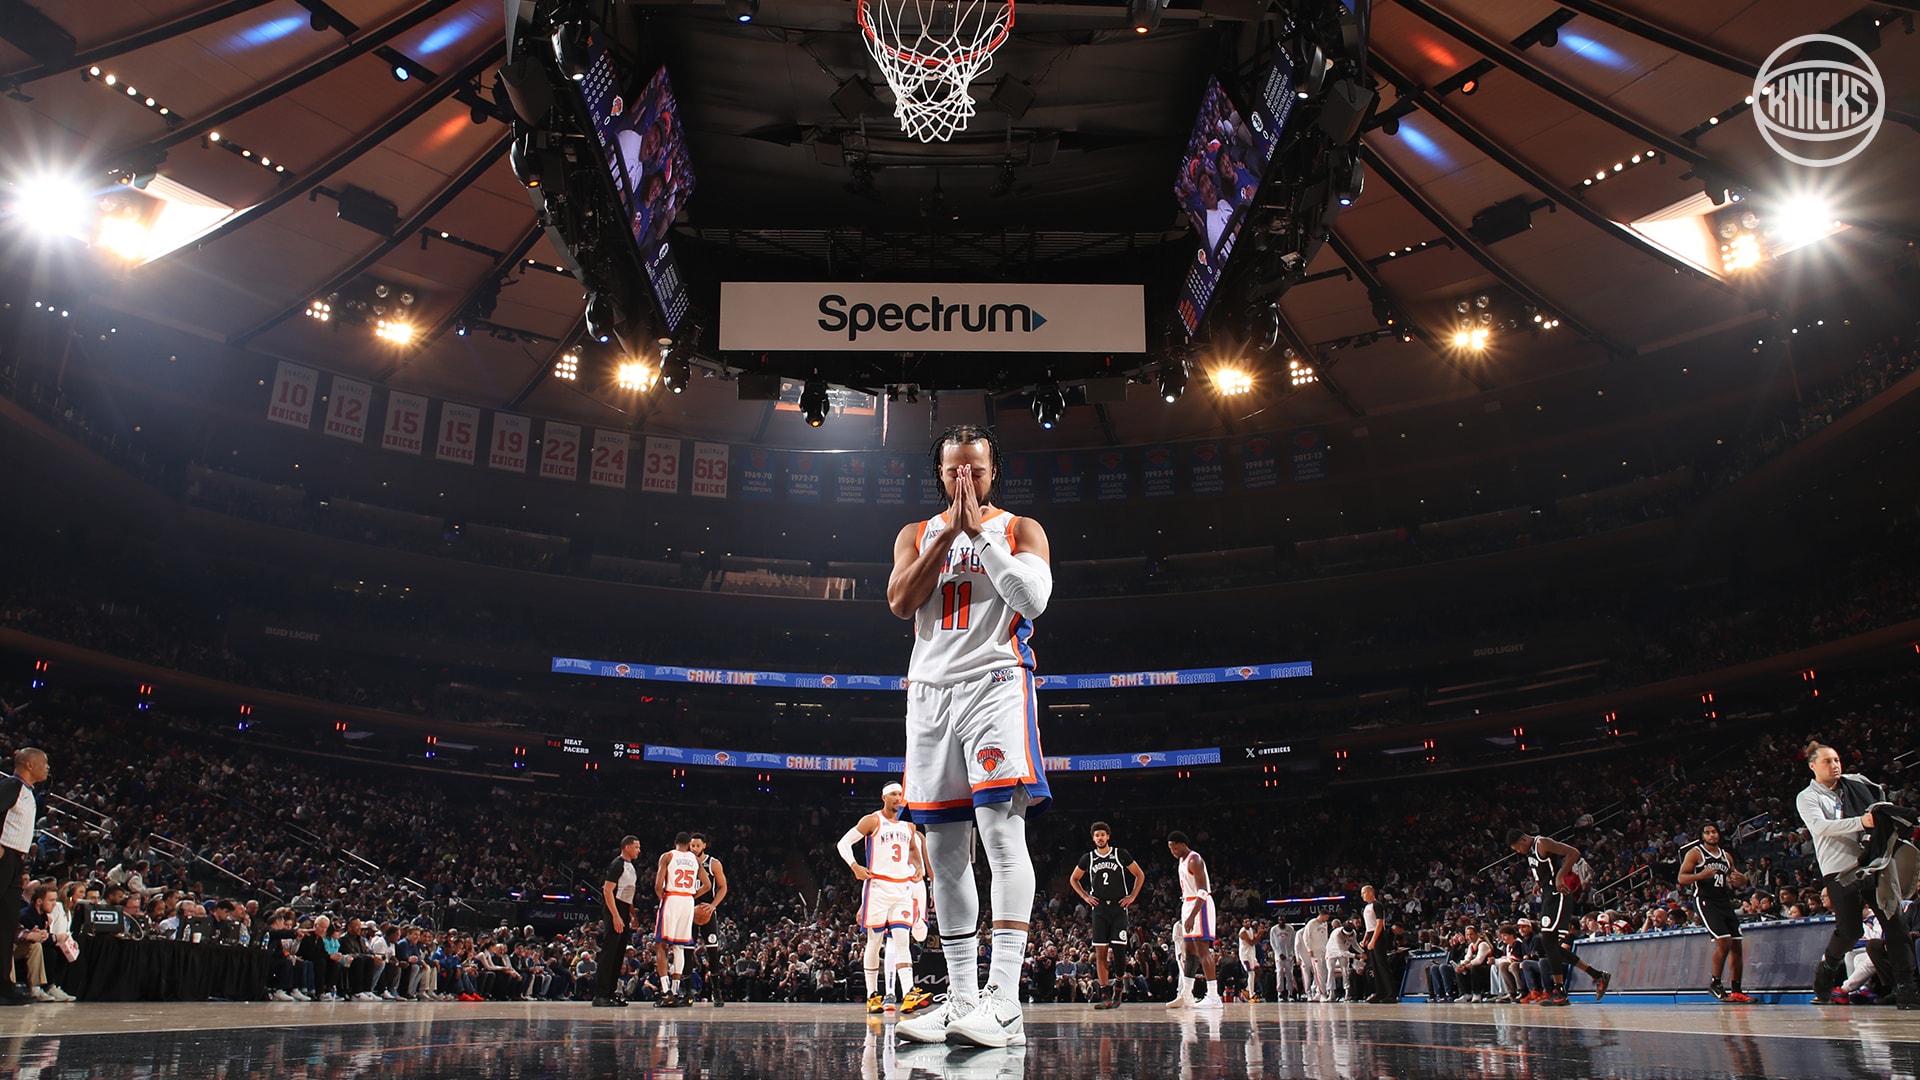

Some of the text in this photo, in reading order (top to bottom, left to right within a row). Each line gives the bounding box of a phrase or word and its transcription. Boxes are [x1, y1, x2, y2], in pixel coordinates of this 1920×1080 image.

[818, 294, 1031, 341] Spectrum
[279, 381, 308, 407] 10
[270, 406, 308, 424] KNICKS
[335, 396, 362, 422] 12
[328, 420, 362, 438] KNICKS
[392, 410, 419, 434] 15
[446, 420, 472, 444] 15
[384, 434, 420, 450] KNICKS
[498, 430, 522, 452] 19
[439, 445, 472, 460] KNICKS
[545, 438, 576, 462] 22
[492, 454, 524, 468] KNICKS
[595, 446, 624, 470] 24
[646, 453, 676, 475] 33
[542, 463, 576, 476] KNICKS
[694, 458, 726, 480] 613
[592, 470, 624, 484] KNICKS
[644, 478, 676, 490] KNICKS
[694, 482, 725, 494] KNICKS
[942, 581, 972, 630] 11
[1473, 643, 1525, 656] BUD LIGHT
[687, 670, 757, 685] GAME TIME
[1110, 671, 1179, 686] GAME TIME
[1179, 673, 1216, 684] OREVER
[563, 746, 590, 754] PACERS
[786, 756, 856, 770] GAME TIME
[1079, 759, 1122, 770] FOREVER
[1177, 752, 1220, 765] FOREVER
[892, 844, 901, 862] 3
[1092, 862, 1118, 873] BROOKLYN
[674, 868, 694, 889] 25
[1102, 872, 1109, 885] 2
[1714, 874, 1724, 887] 24
[563, 912, 590, 920] ULTRA
